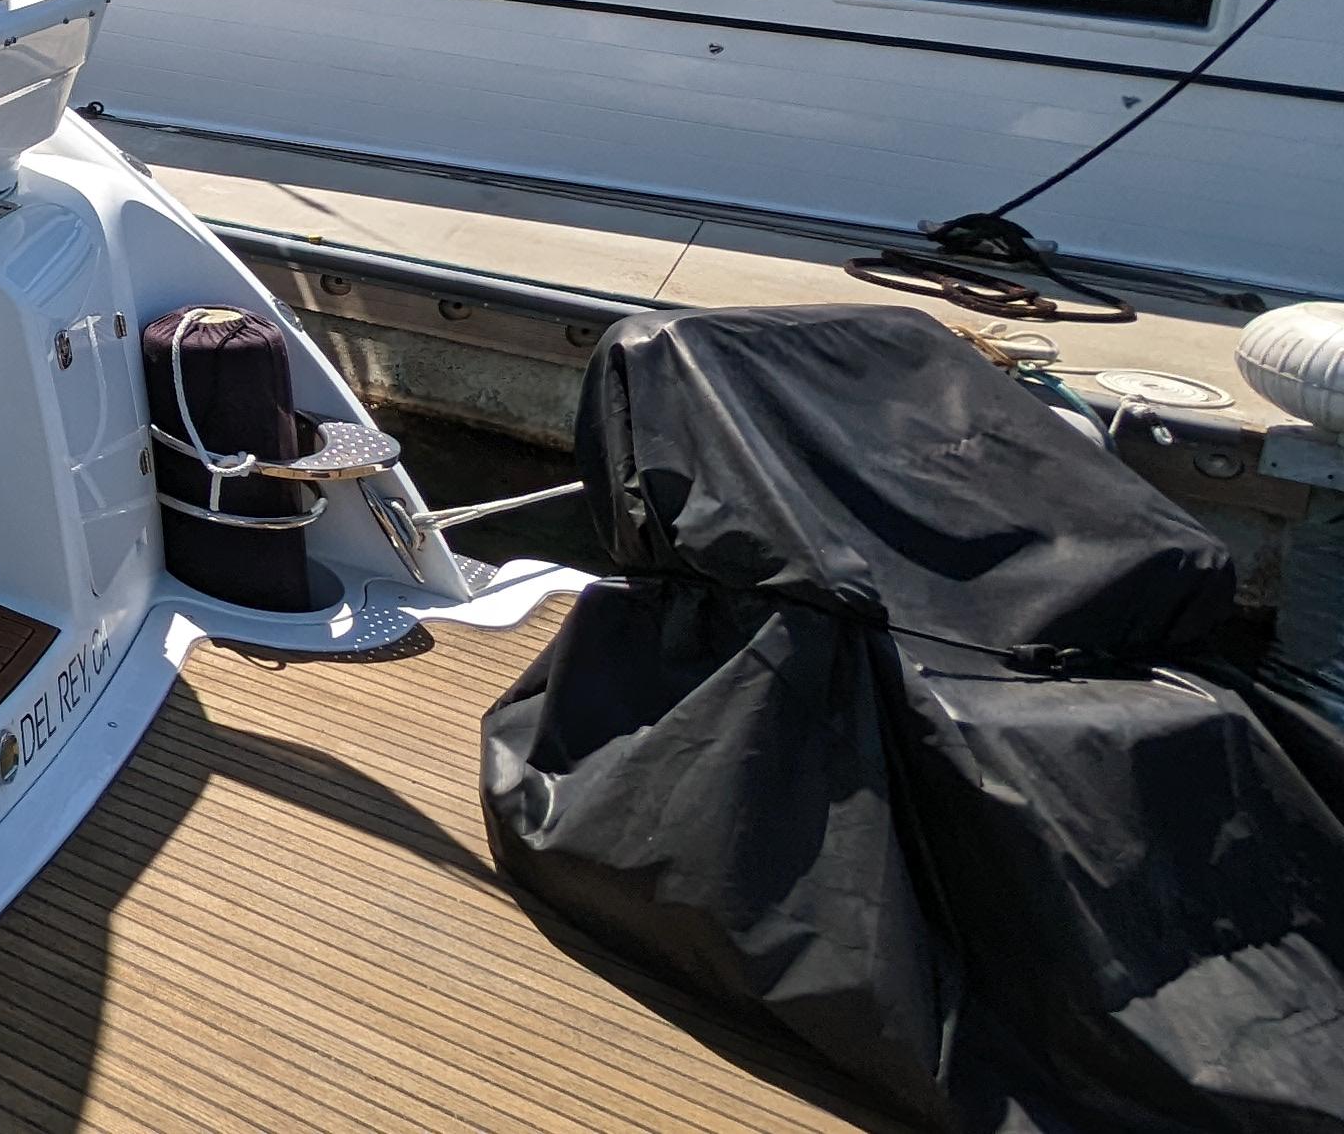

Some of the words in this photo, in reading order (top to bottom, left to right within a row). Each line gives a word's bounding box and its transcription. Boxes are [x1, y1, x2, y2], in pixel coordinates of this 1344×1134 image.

[19, 692, 57, 768] DEL
[57, 643, 91, 722] REY,
[91, 618, 112, 675] CA
